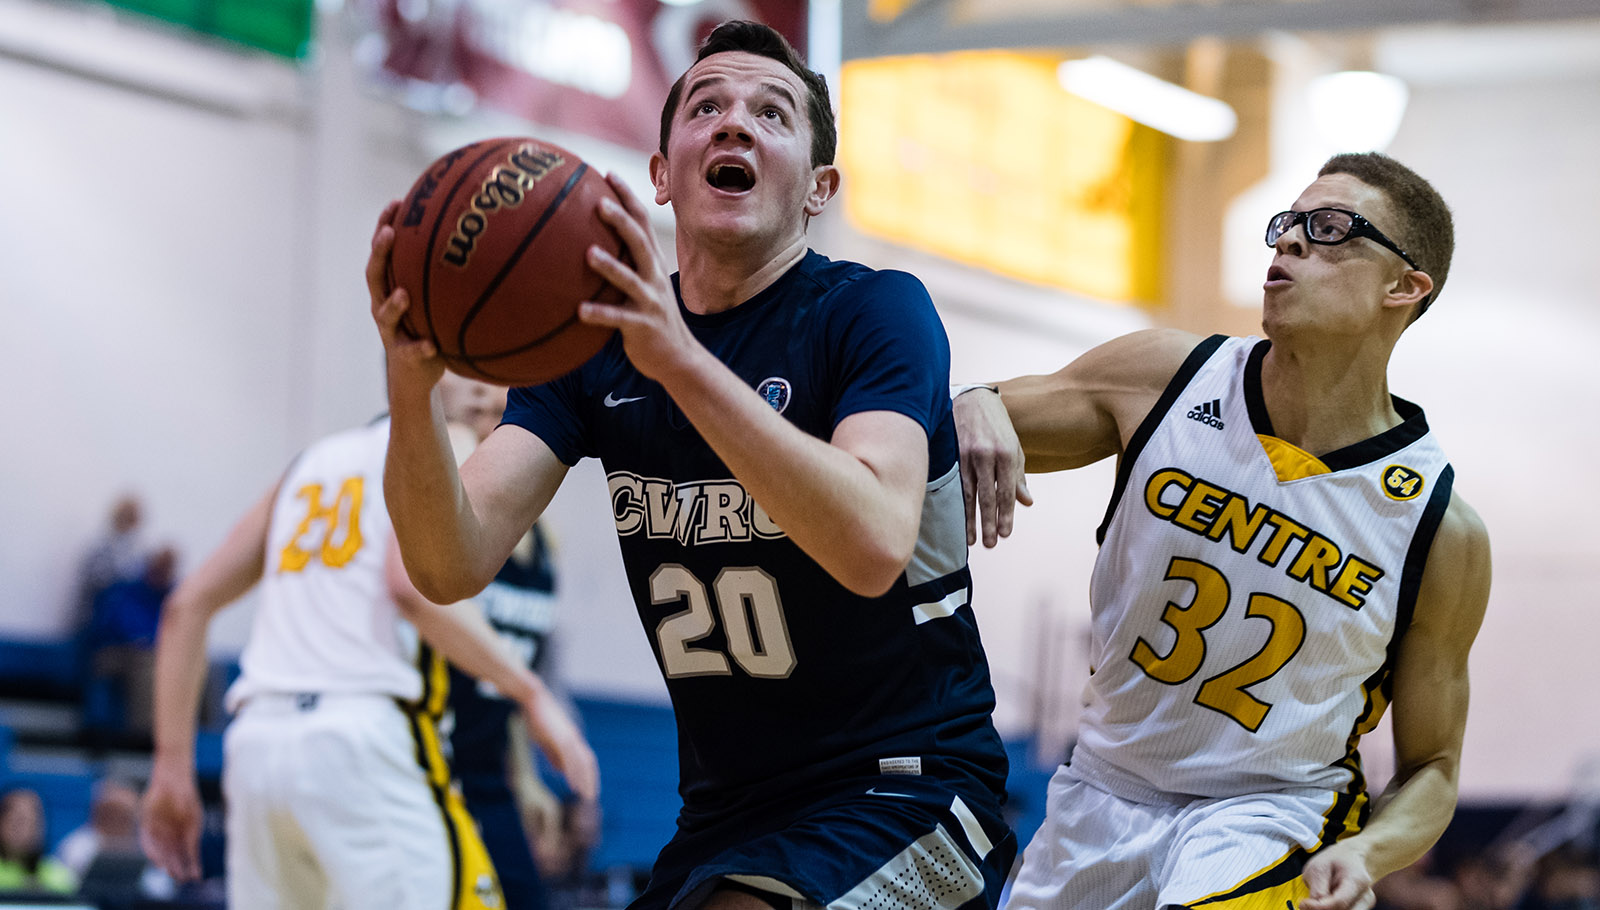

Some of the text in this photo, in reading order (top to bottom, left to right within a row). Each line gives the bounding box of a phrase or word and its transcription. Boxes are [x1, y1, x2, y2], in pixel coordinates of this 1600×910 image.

[442, 143, 566, 268] Wilson
[1186, 410, 1225, 431] adidas
[1144, 467, 1385, 611] CENTRE
[1387, 468, 1420, 496] 54
[649, 563, 798, 680] 20
[1128, 556, 1307, 733] 32
